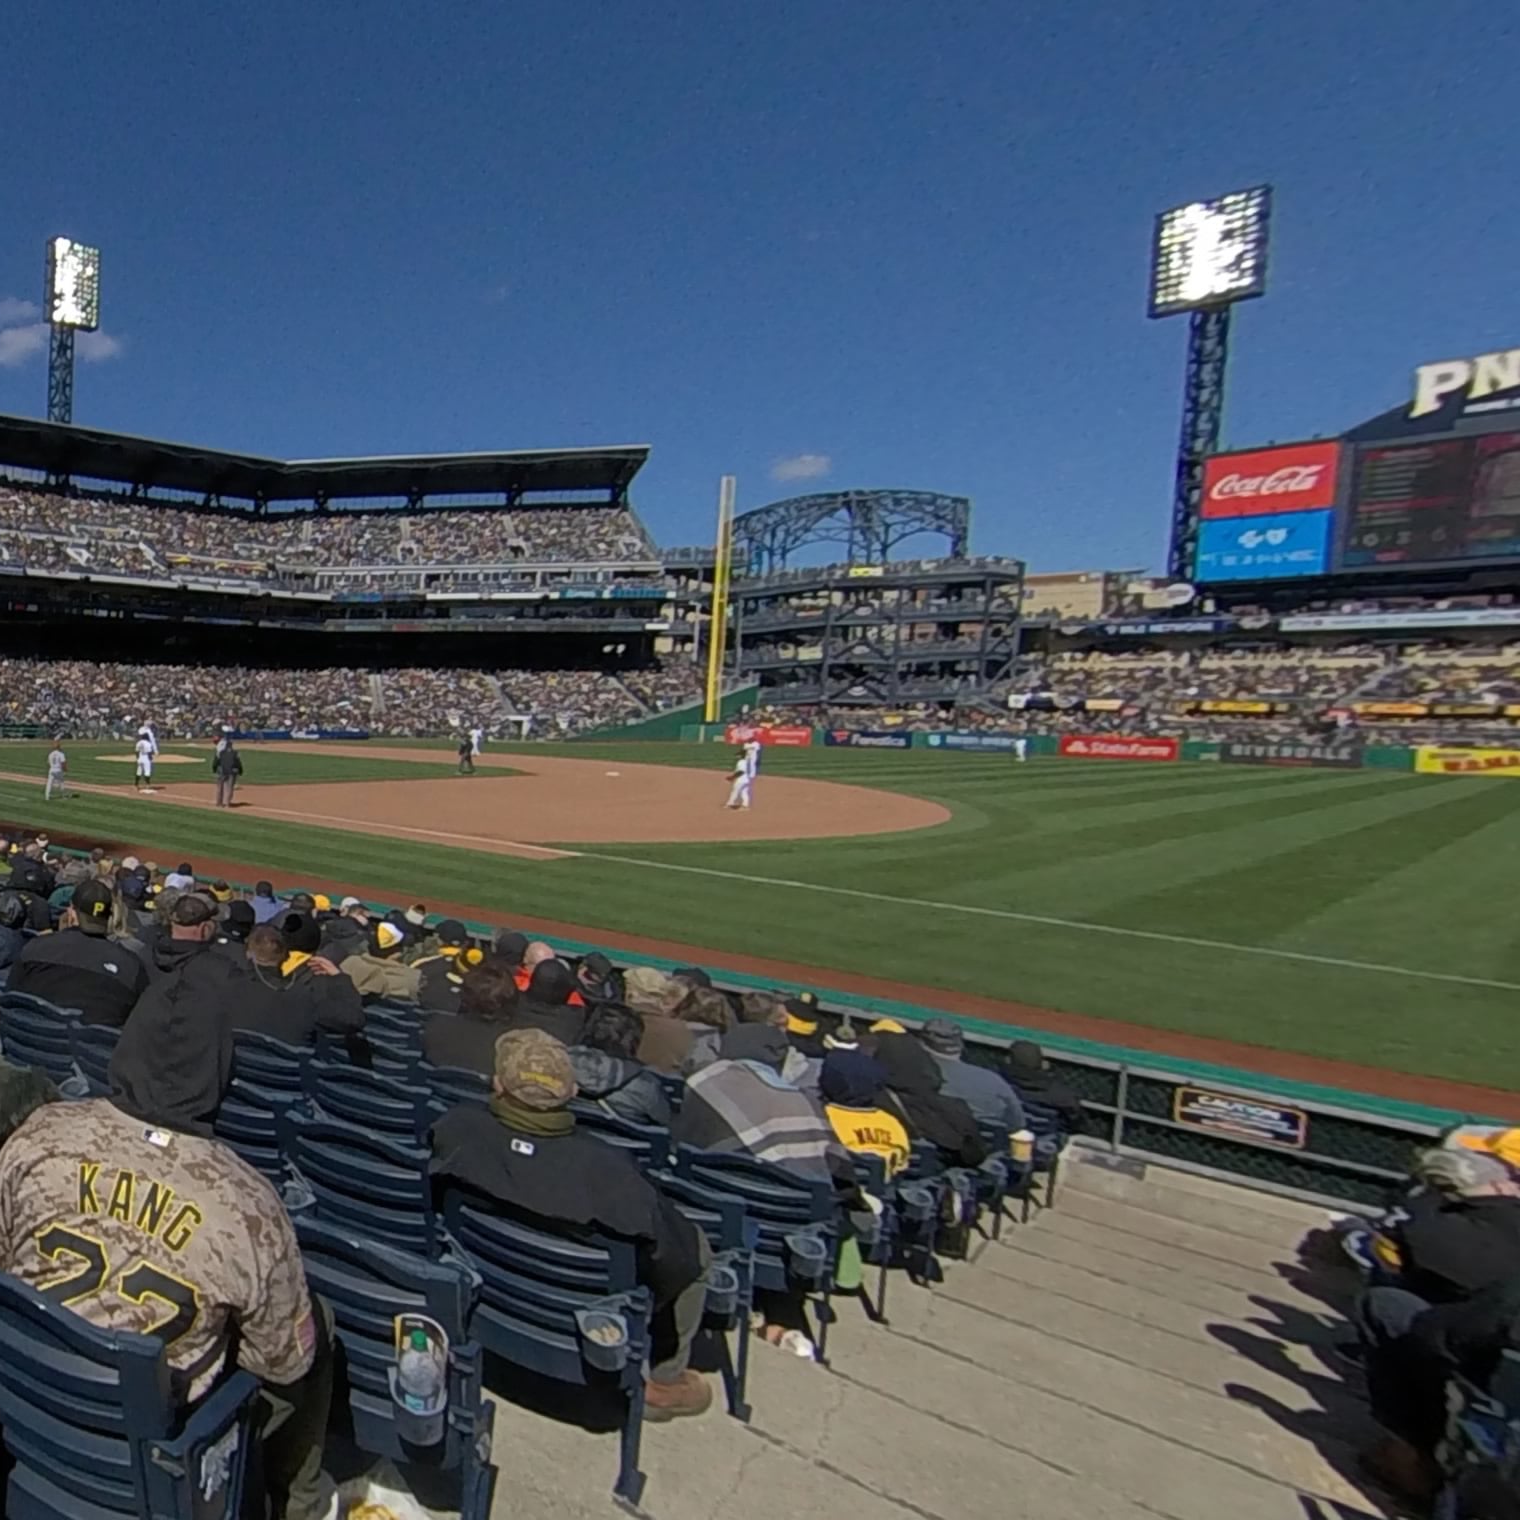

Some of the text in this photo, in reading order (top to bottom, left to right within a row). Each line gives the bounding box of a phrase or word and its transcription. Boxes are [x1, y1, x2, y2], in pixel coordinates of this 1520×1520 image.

[1408, 350, 1520, 418] PN
[850, 734, 907, 747] Fanatics
[93, 902, 105, 916] P
[79, 1162, 204, 1253] KANG
